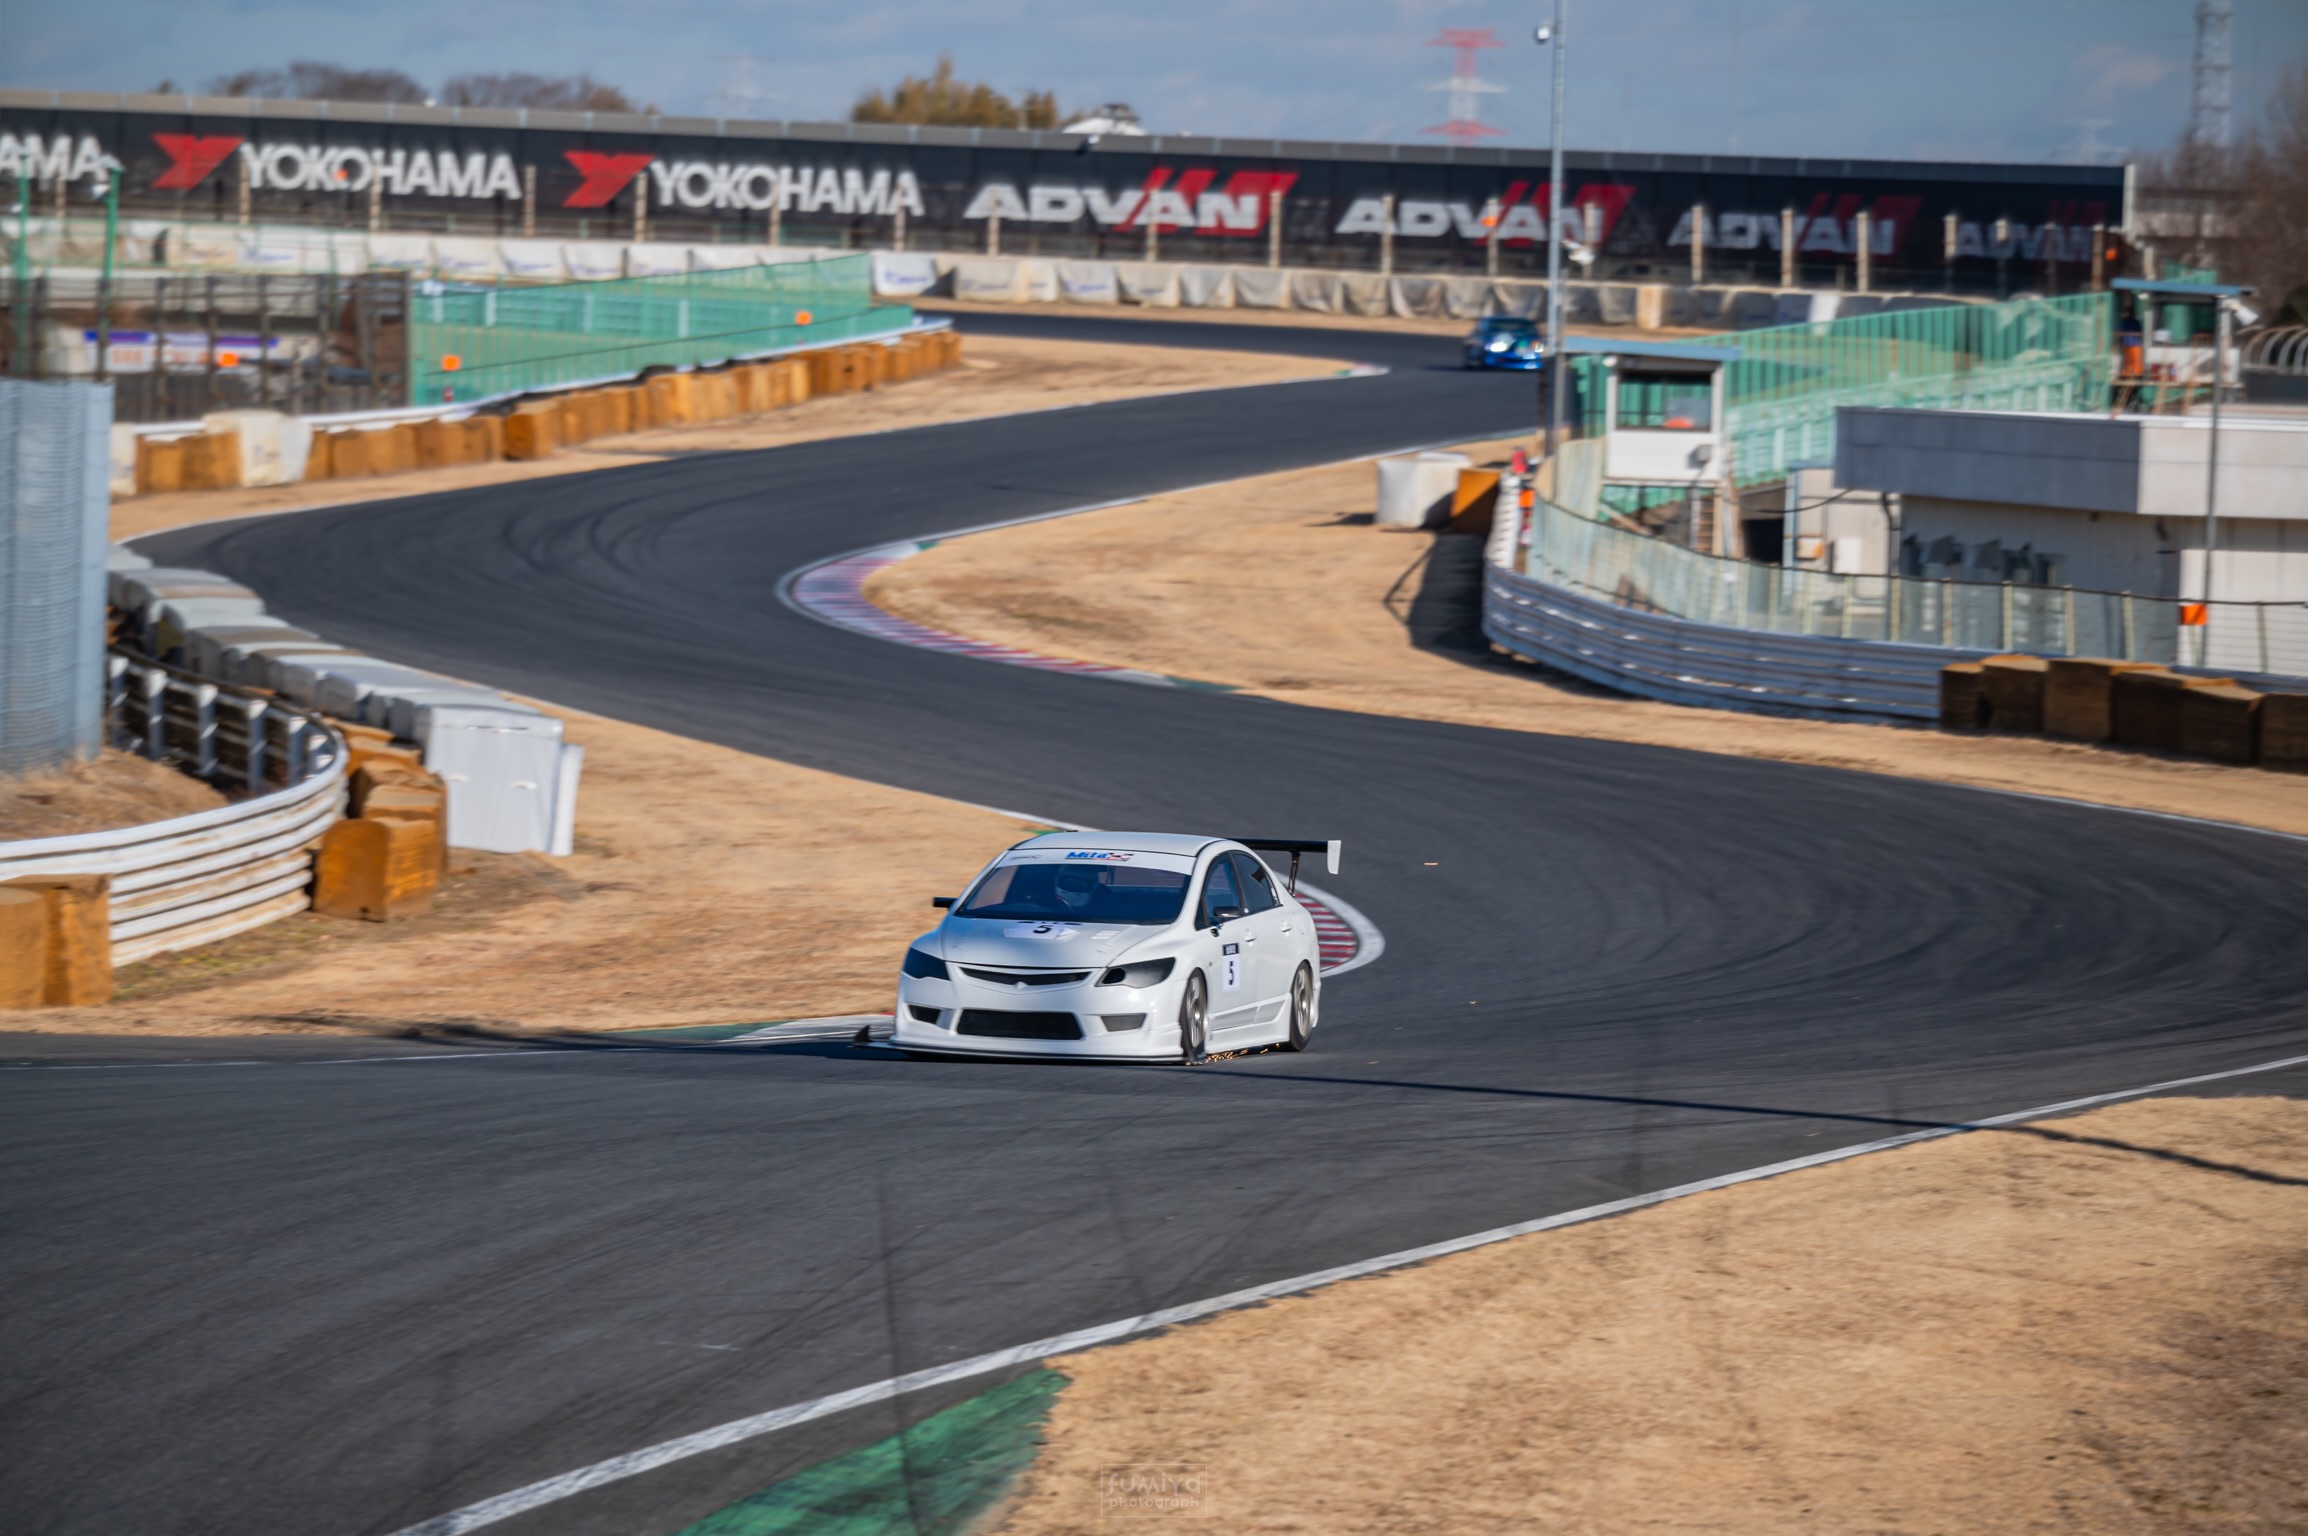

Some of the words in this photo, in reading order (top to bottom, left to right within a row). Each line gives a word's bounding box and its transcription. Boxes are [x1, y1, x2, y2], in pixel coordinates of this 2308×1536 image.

[240, 143, 521, 199] YOKOHAMA
[651, 160, 925, 216] YOKOHAMA
[963, 184, 1260, 229] ADVAN
[1335, 199, 1605, 244] ADVAN
[1667, 211, 1895, 255] ADVAN
[1033, 925, 1053, 934] 5
[1229, 961, 1234, 985] 5
